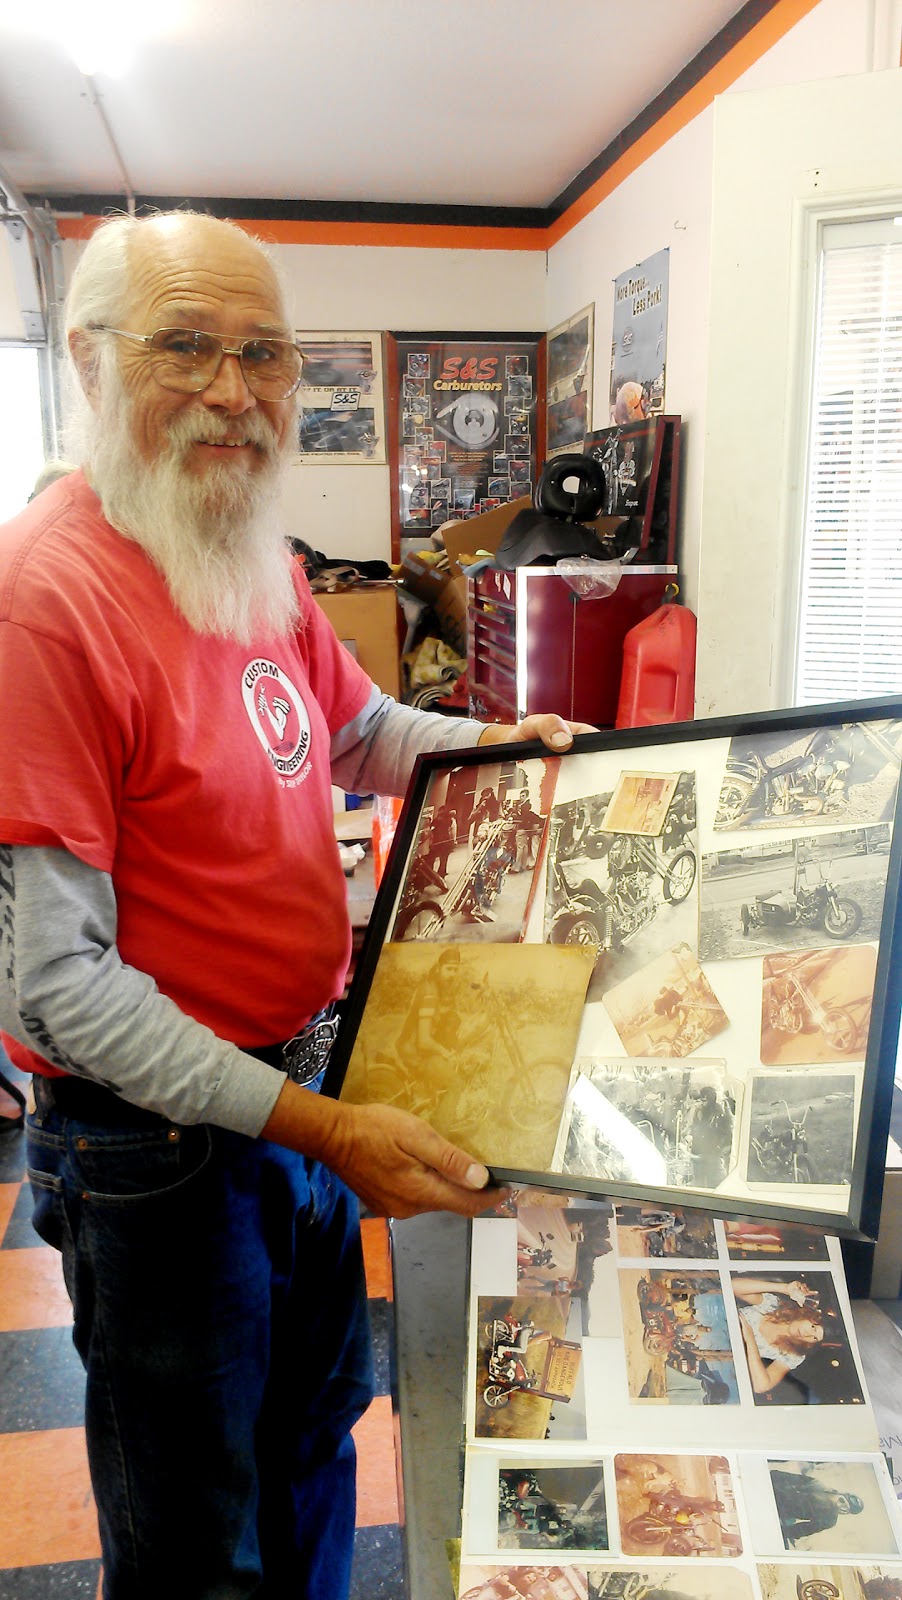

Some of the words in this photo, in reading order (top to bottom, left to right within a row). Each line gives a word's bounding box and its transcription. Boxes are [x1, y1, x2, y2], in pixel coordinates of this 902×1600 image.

[633, 298, 646, 315] Less
[440, 357, 499, 379] S&S
[433, 380, 502, 391] Carburetors
[333, 393, 358, 404] S&S
[244, 662, 279, 689] CUSTOM
[558, 1361, 569, 1391] DANGEROUS
[567, 1361, 575, 1385] BUFFALO
